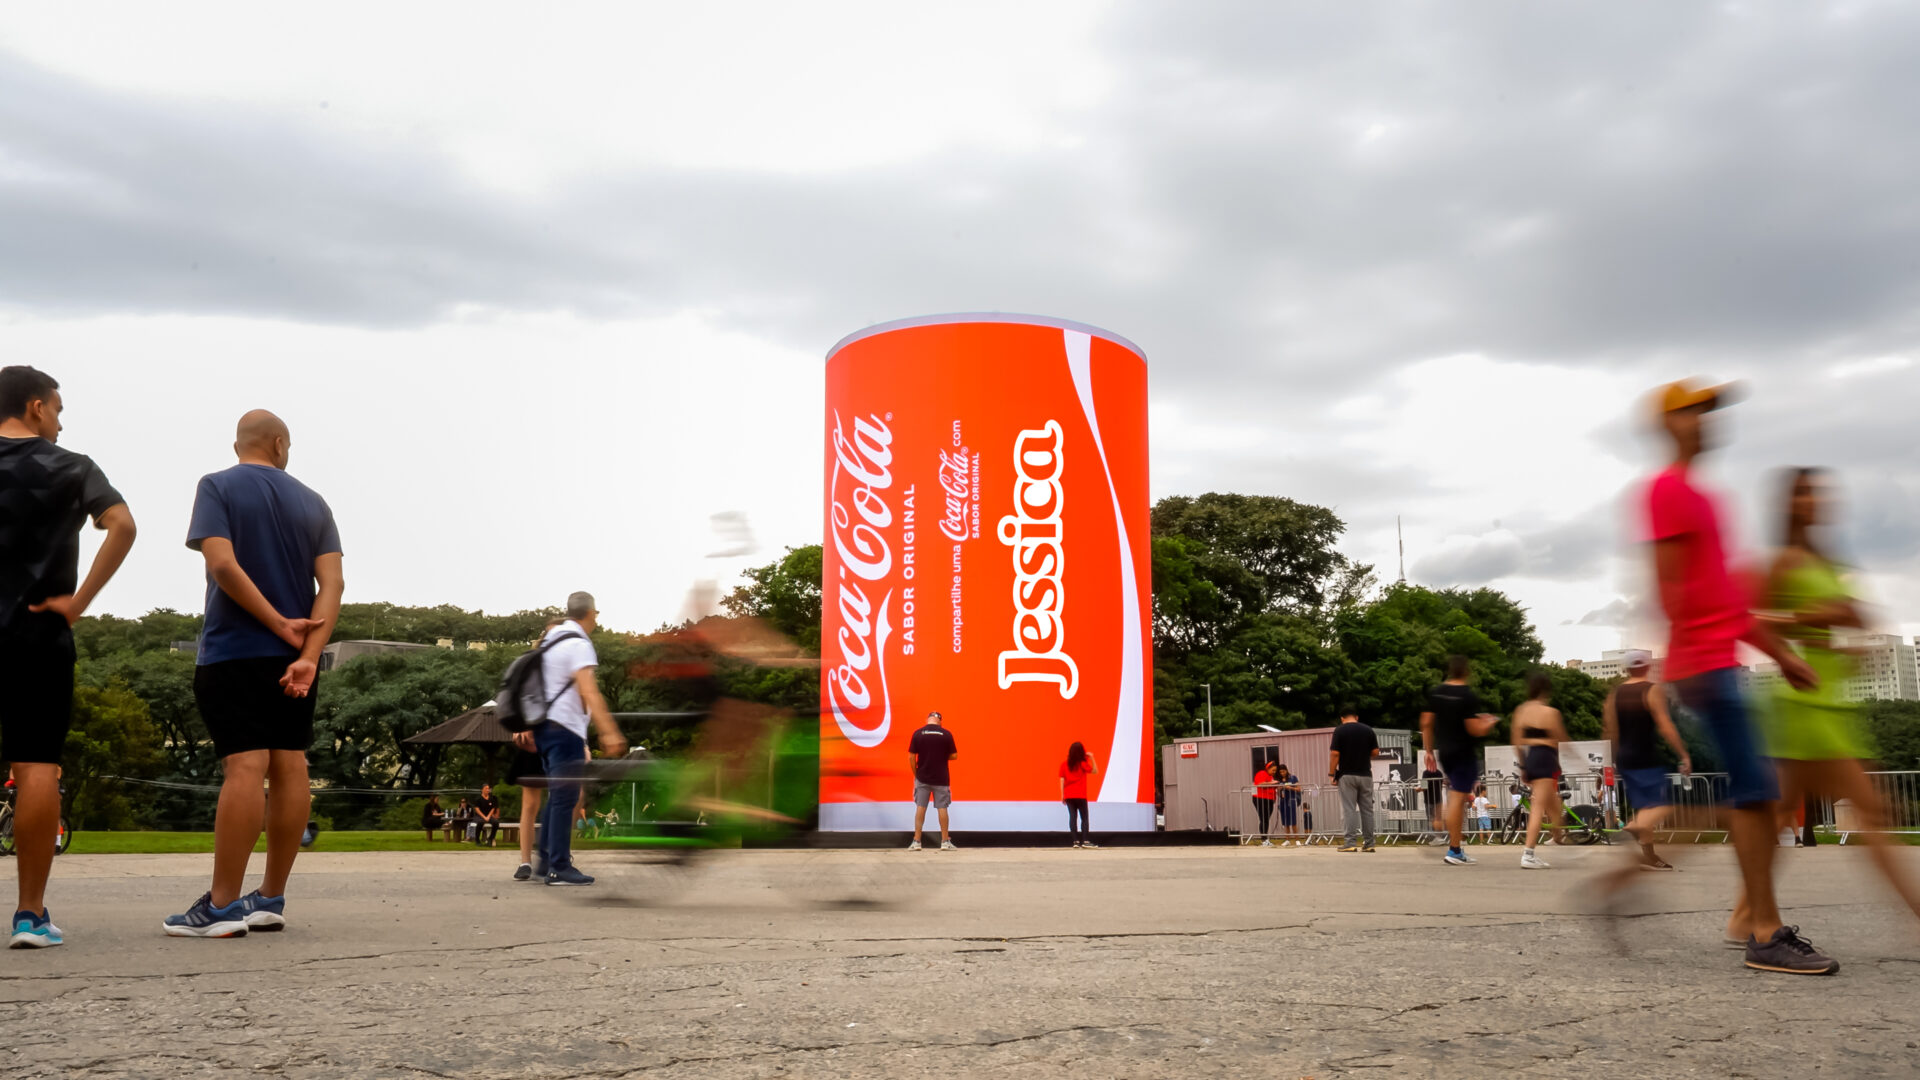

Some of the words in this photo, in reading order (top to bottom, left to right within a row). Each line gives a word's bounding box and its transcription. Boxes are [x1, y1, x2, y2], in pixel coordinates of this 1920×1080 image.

[953, 420, 961, 447] com
[939, 448, 969, 542] Coca-Cola
[972, 452, 980, 501] ORIGINAL
[903, 484, 915, 579] ORIGINAL
[972, 504, 980, 539] SABOR
[827, 408, 893, 748] Coca-Cola
[953, 545, 961, 574] uma
[997, 419, 1079, 700] Jessica
[903, 587, 915, 655] SABOR
[951, 575, 964, 653] compartilhe
